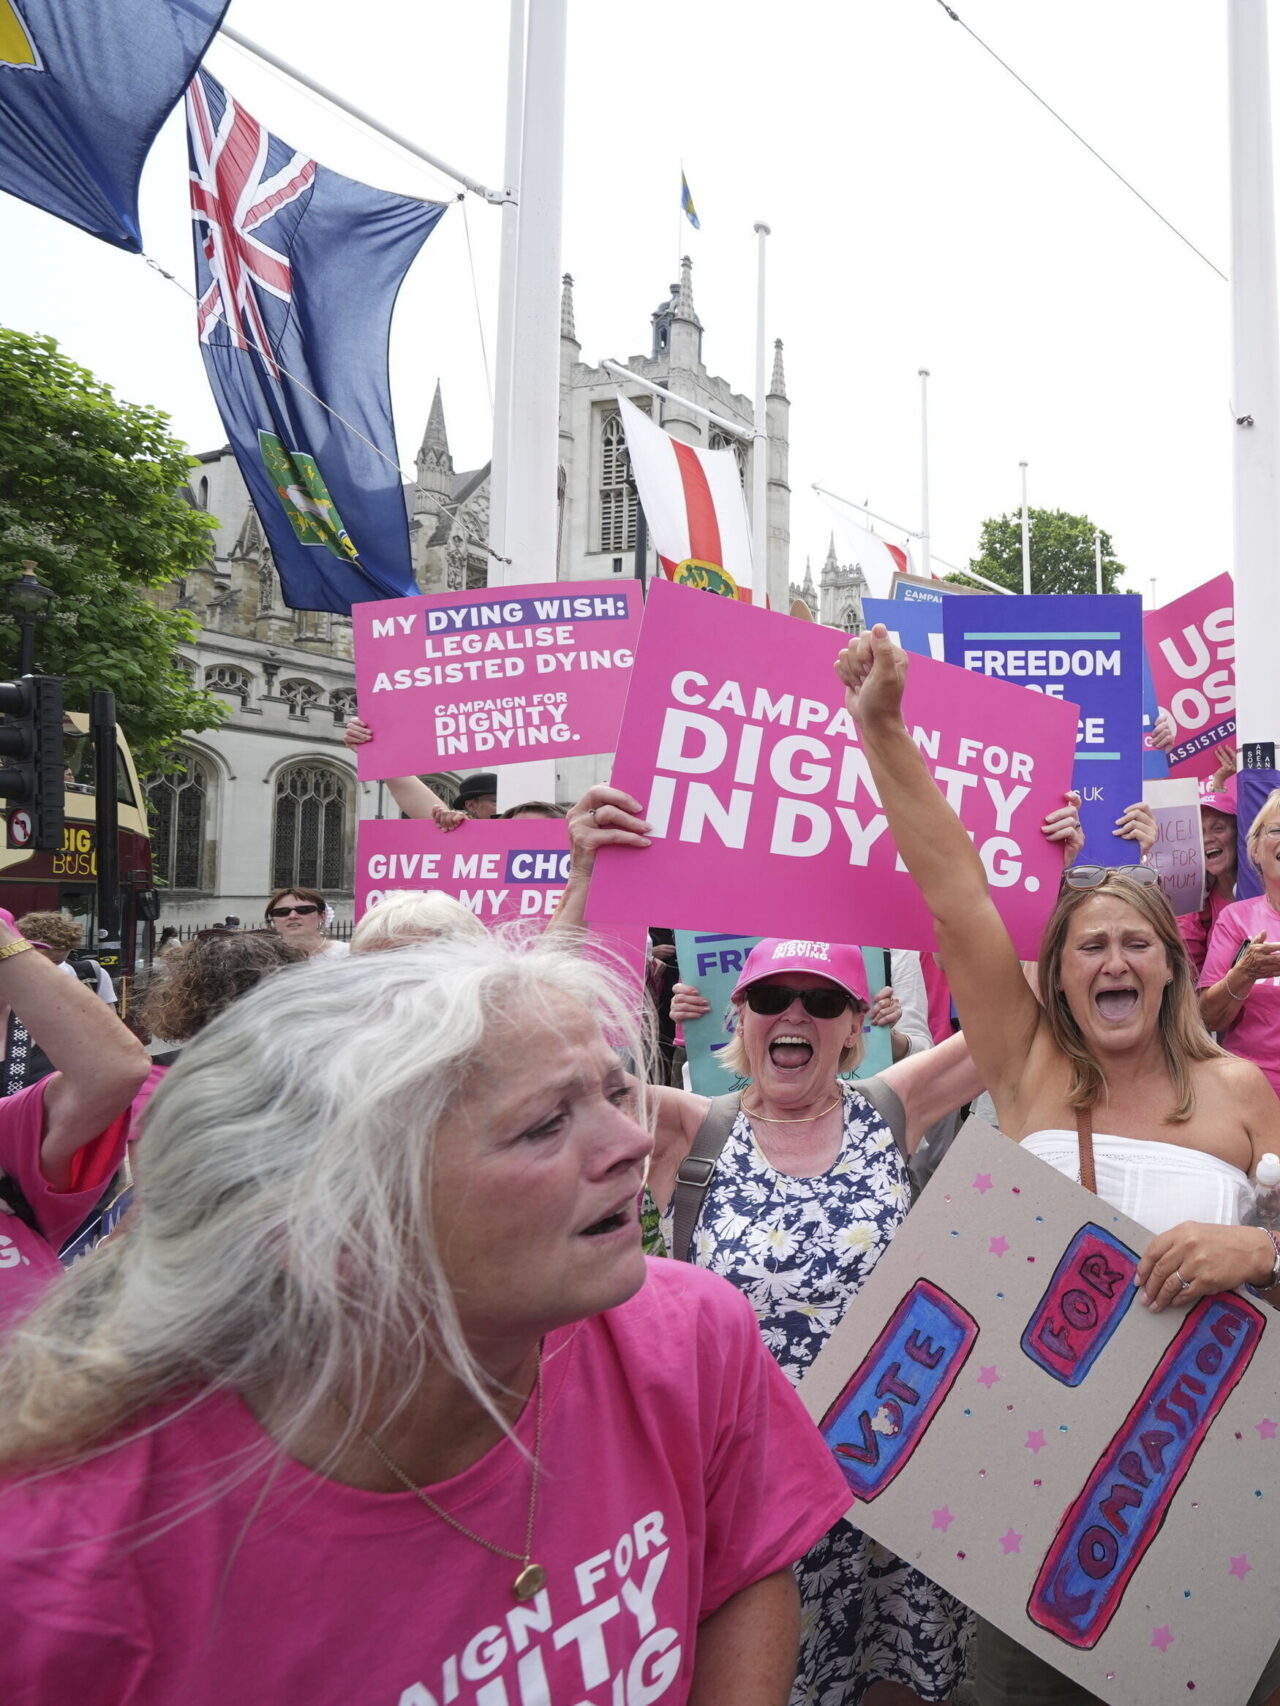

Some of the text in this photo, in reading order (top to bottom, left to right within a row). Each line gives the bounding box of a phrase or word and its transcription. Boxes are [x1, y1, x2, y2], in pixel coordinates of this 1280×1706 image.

[372, 597, 626, 639] MY DYING WISH:
[425, 625, 575, 659] LEGALISE
[372, 648, 634, 693] ASSISTED DYING
[964, 650, 1121, 676] FREEDOM
[434, 692, 568, 716] CAMPAIGN FOR
[435, 704, 568, 737] DIGNITY
[436, 723, 582, 756] IN DYING.
[670, 670, 1035, 783] CAMPAN FOR
[1169, 721, 1236, 764] ASSISTED
[655, 707, 1032, 833] DIGNTY
[1083, 787, 1104, 801] UK
[645, 775, 1040, 892] IN DYG.
[368, 853, 573, 880] GIVE ME CHO
[1172, 849, 1197, 867] FOR
[1163, 872, 1197, 891] MUM
[458, 889, 510, 915] MY
[1040, 1252, 1127, 1362] FOR
[835, 1328, 945, 1468] VOTE
[1052, 1312, 1244, 1620] COMPASSION
[574, 1510, 669, 1606] FOR
